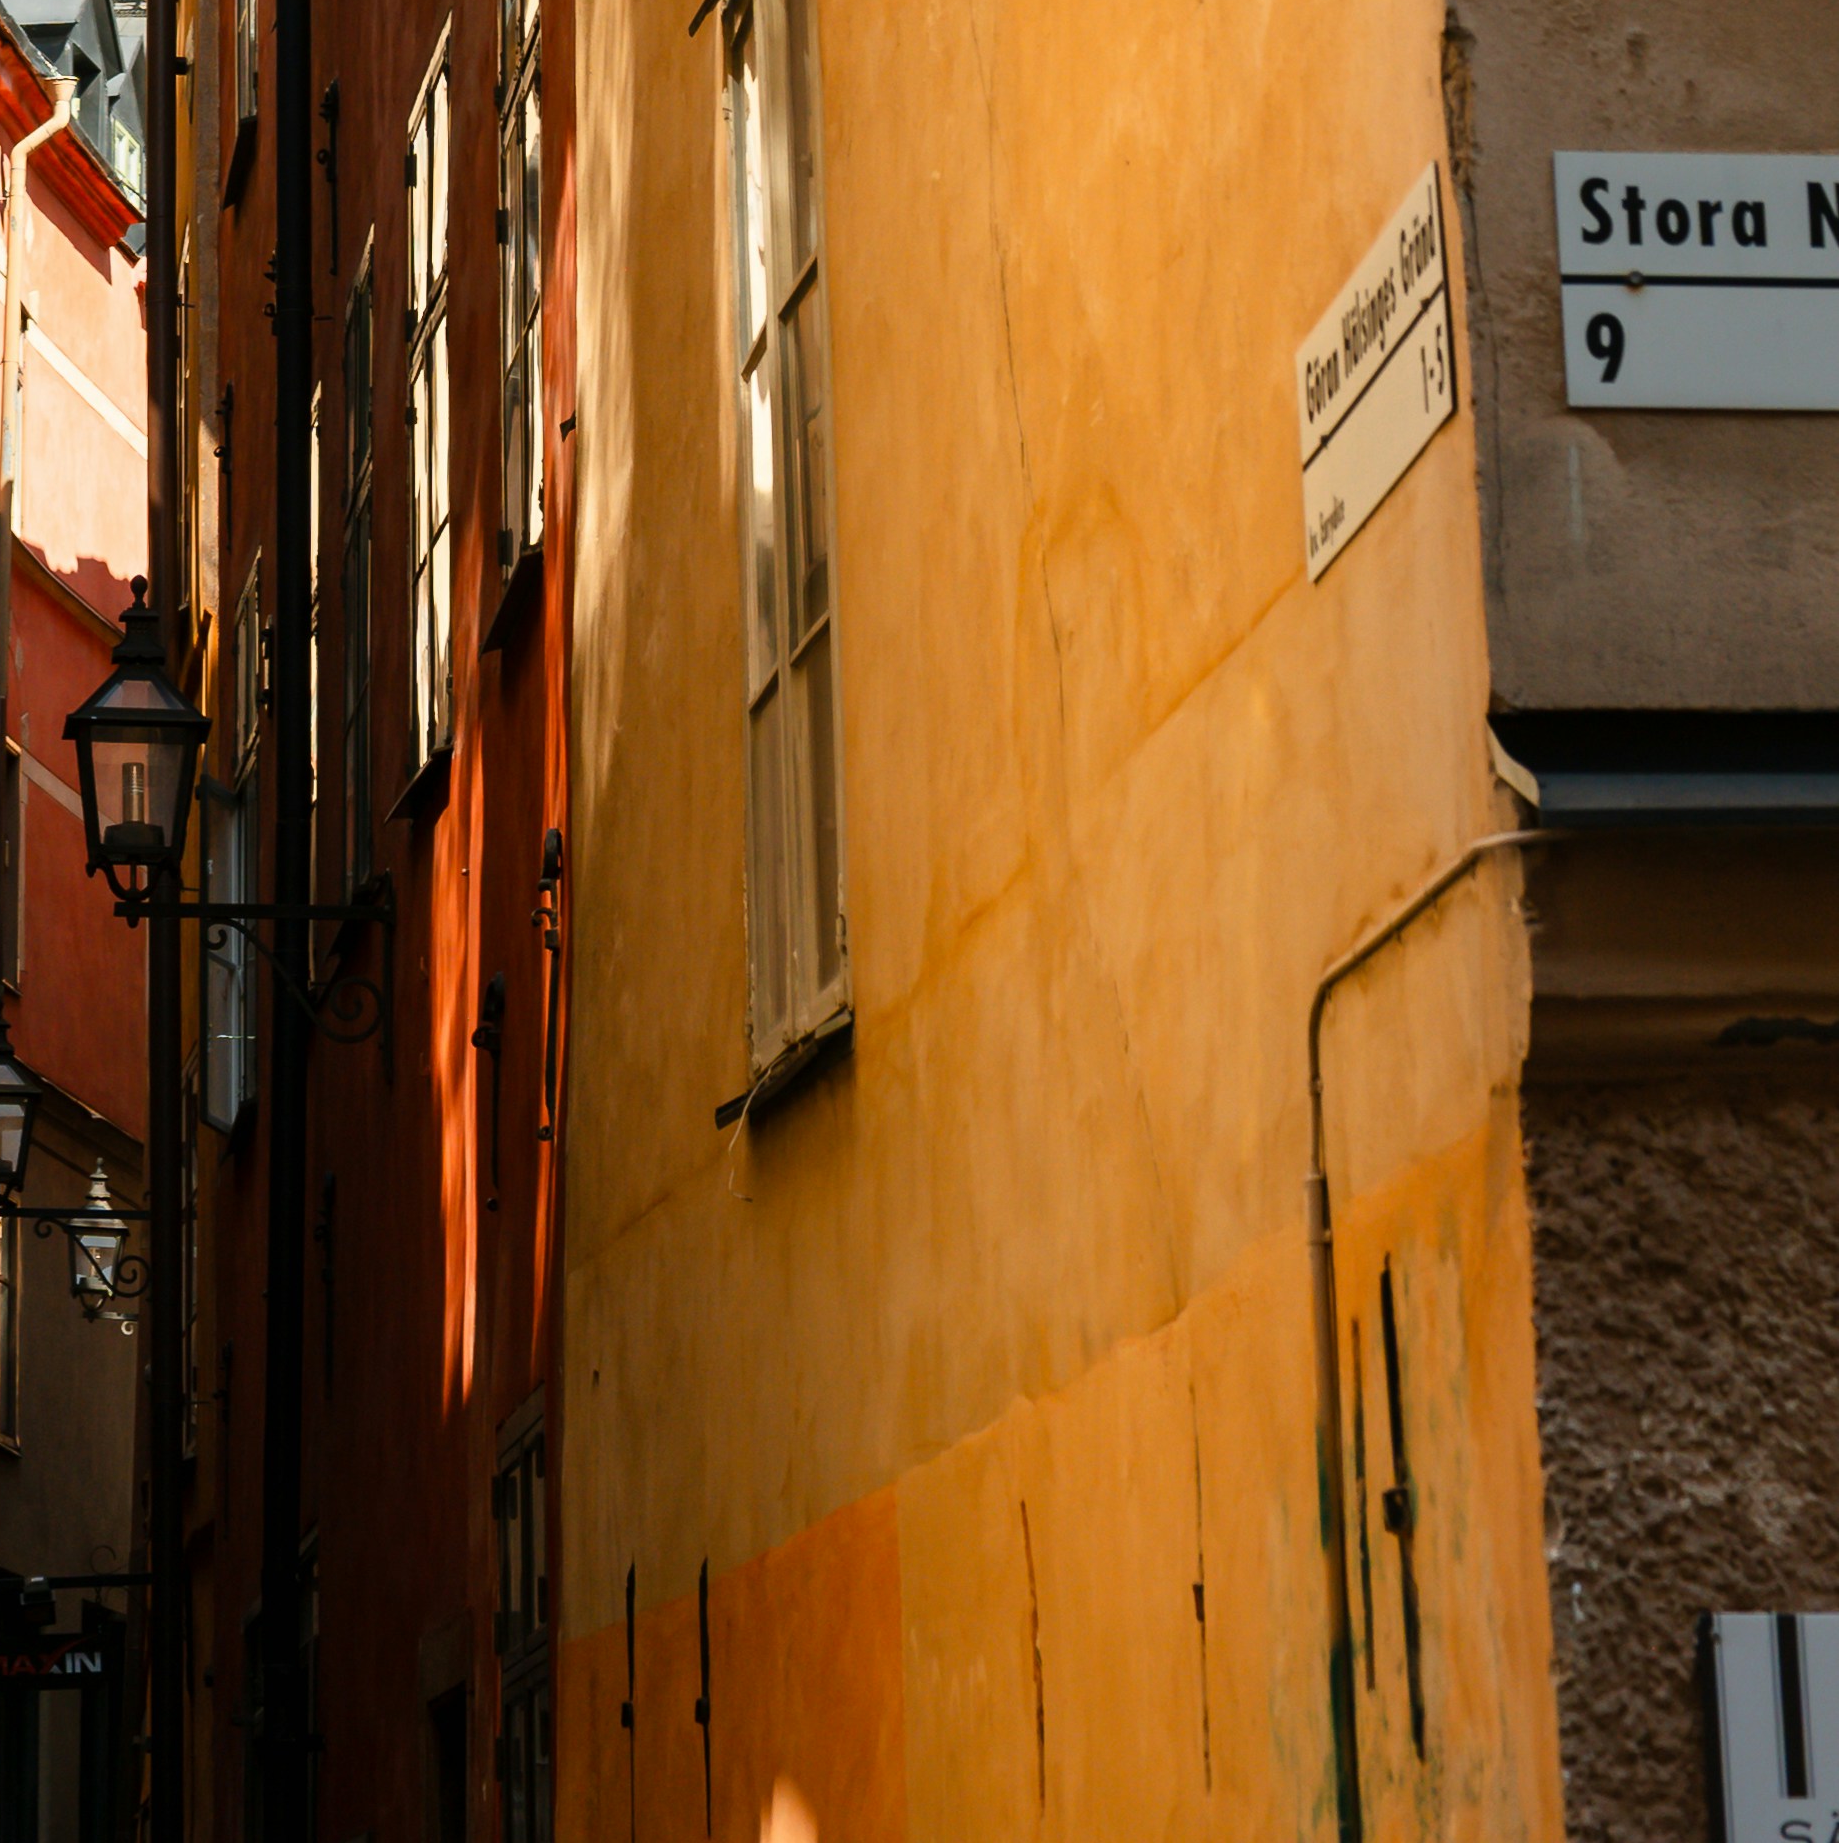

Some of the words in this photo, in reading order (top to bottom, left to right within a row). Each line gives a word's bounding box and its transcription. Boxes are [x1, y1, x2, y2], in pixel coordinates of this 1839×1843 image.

[1579, 177, 1768, 248] Stora
[1305, 348, 1341, 425] Göran
[1341, 266, 1397, 380] Hälsinges
[1399, 184, 1436, 296] Gränd
[1420, 323, 1445, 414] 1-5
[1585, 311, 1626, 384] 9
